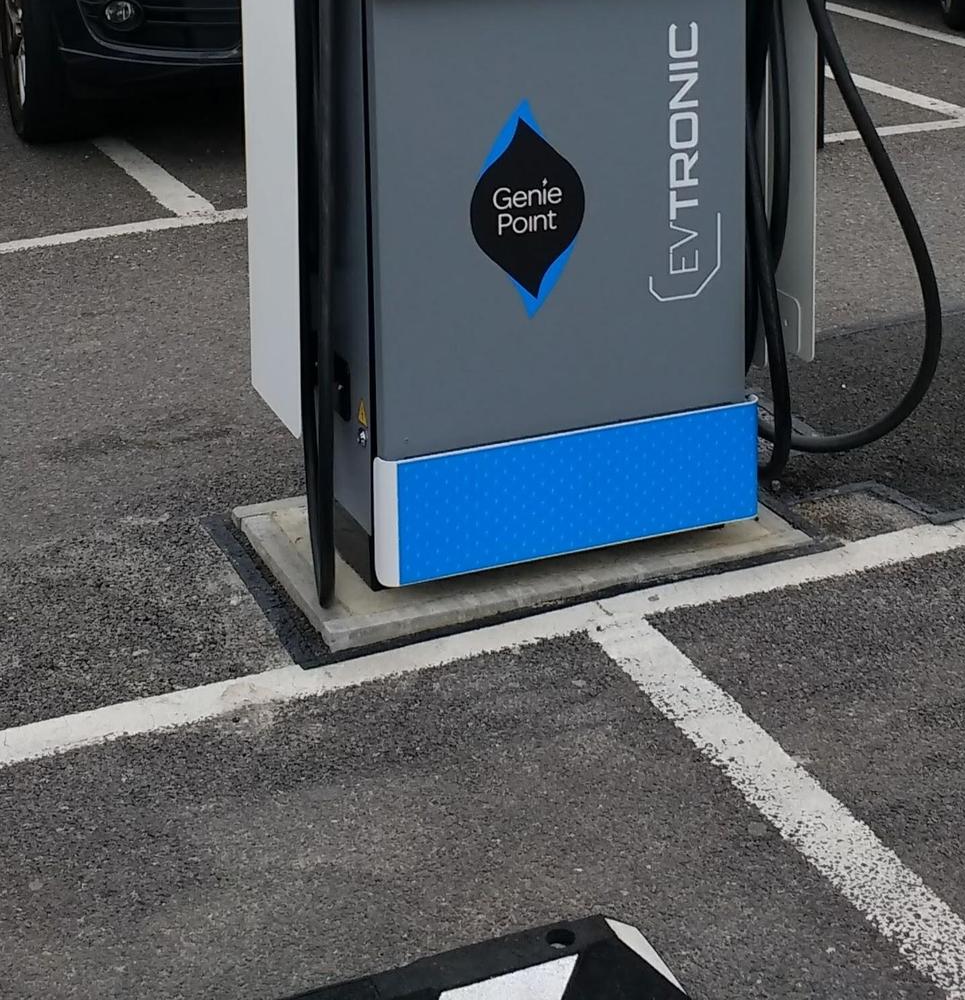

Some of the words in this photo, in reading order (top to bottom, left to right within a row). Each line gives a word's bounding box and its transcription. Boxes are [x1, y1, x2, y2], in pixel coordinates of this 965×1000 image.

[669, 21, 699, 275] EVTRONIC
[493, 178, 562, 210] Genie
[498, 210, 557, 236] Point
